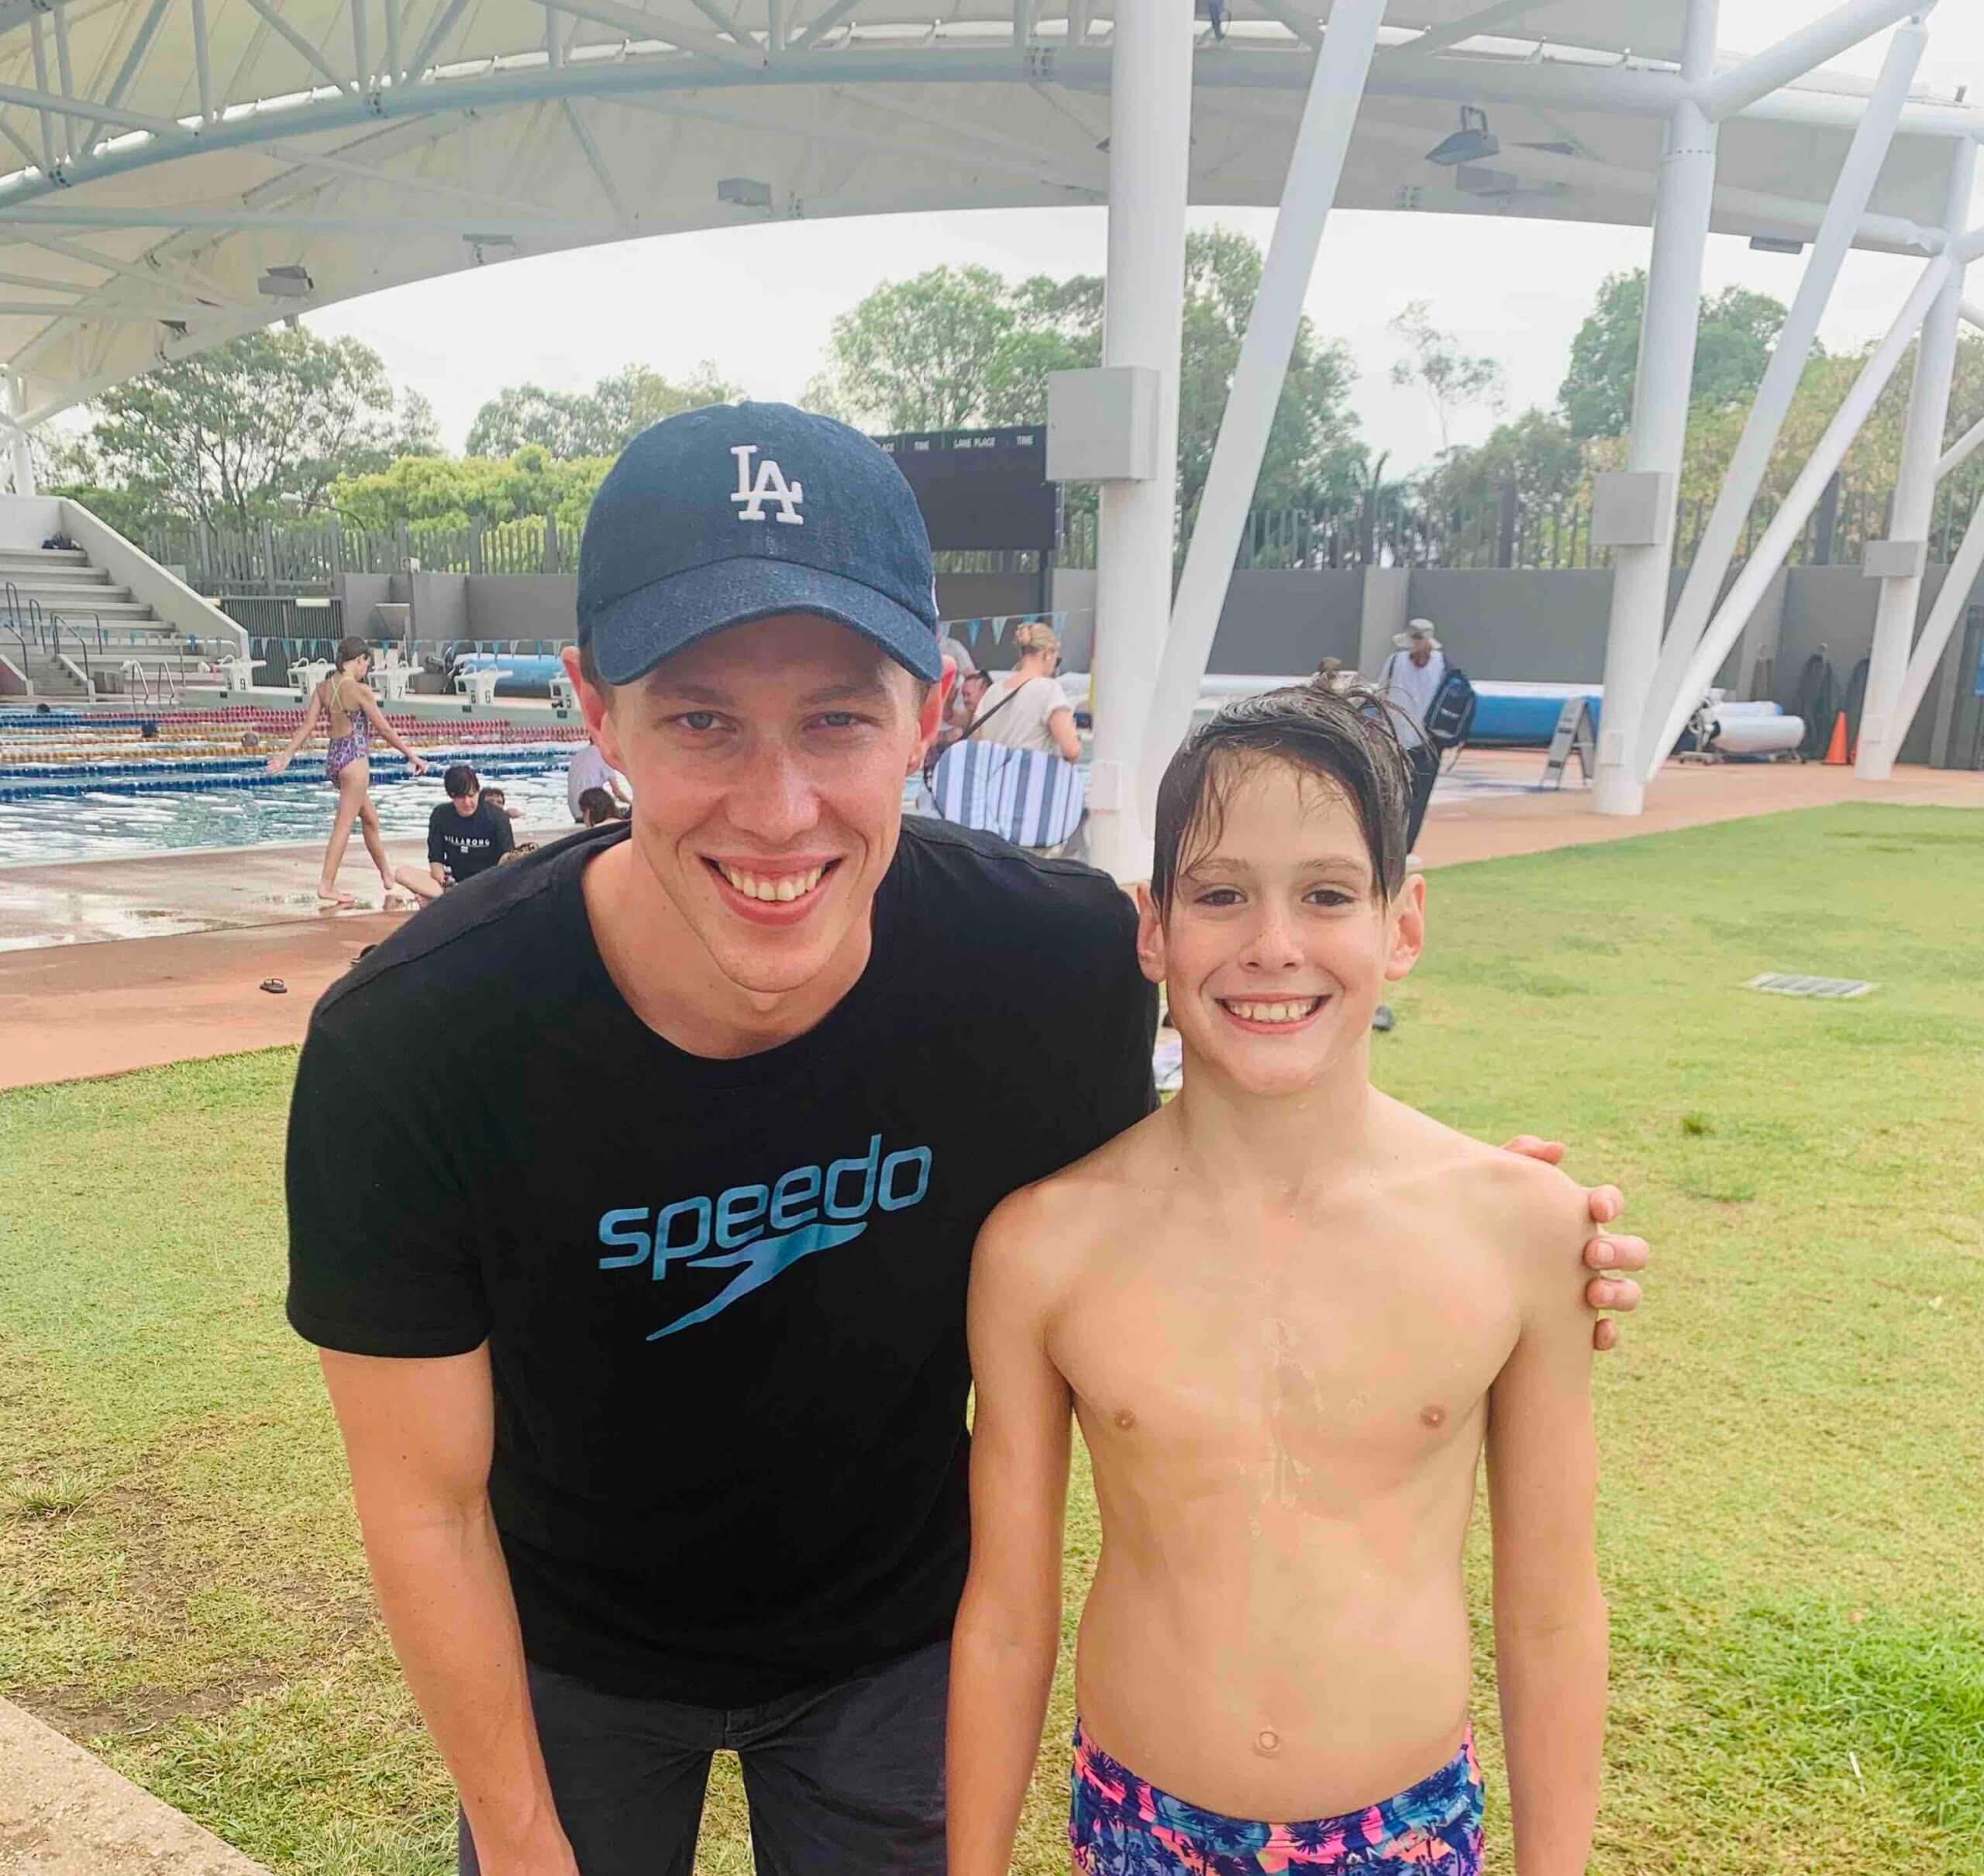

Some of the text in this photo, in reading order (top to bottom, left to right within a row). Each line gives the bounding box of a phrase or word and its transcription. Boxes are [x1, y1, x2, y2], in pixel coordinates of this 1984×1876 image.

[973, 436, 996, 448] PLACE
[730, 445, 804, 525] LA
[598, 1134, 932, 1281] speedo
